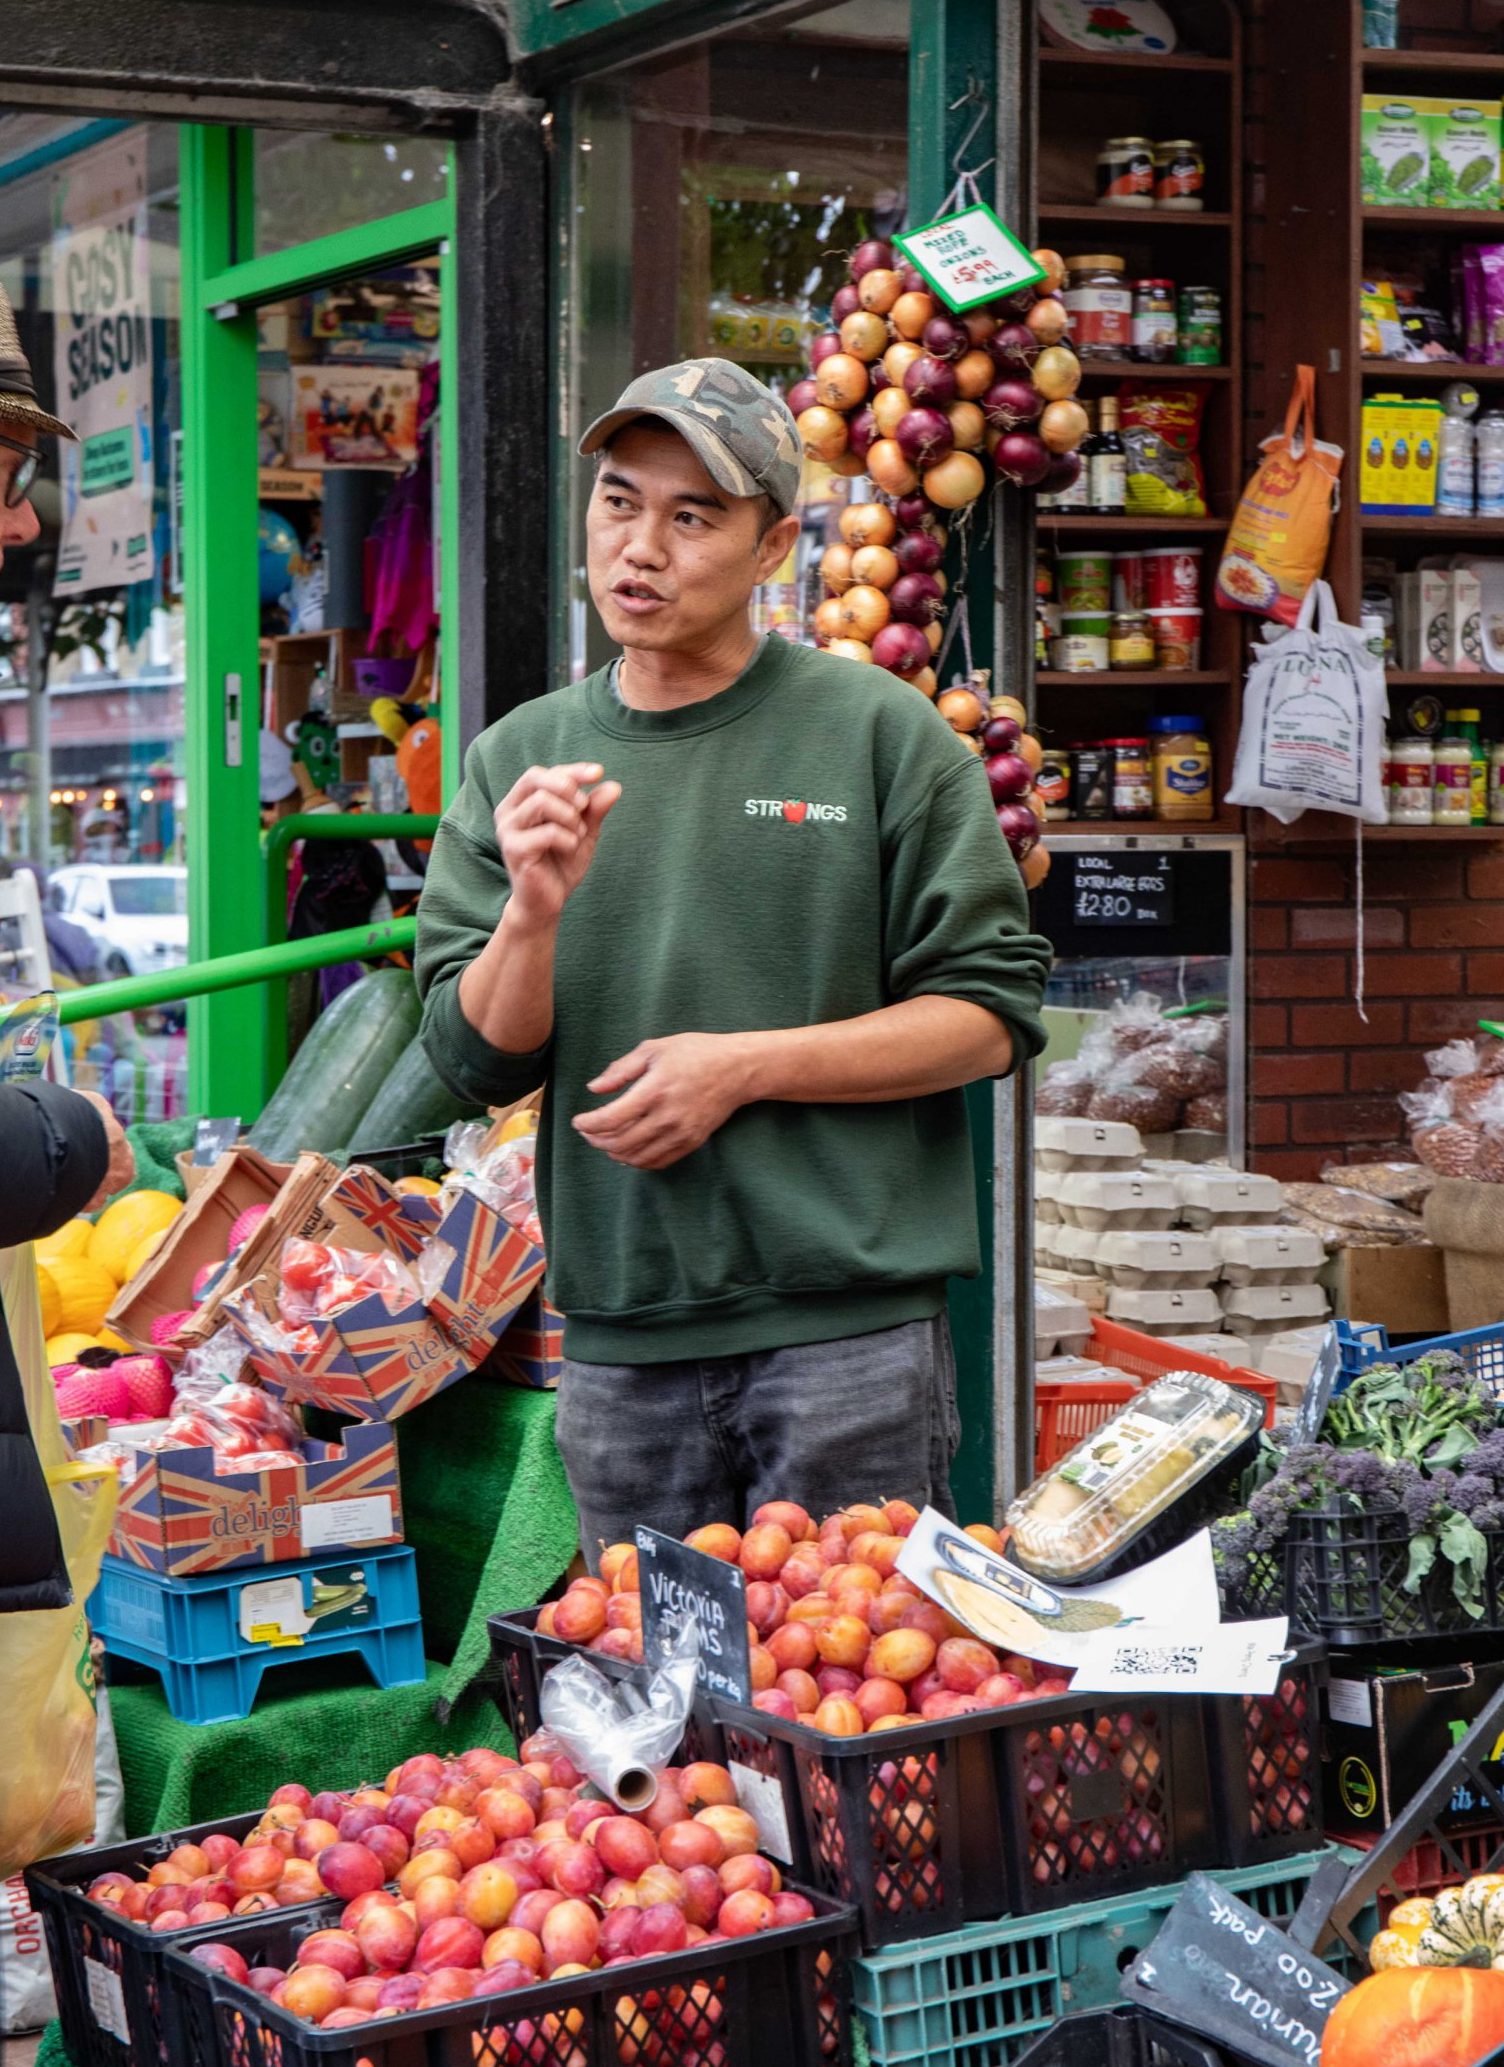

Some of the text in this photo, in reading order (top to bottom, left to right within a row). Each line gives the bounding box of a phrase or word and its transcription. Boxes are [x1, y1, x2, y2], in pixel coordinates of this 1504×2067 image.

[923, 229, 965, 248] MIXED
[939, 245, 987, 268] ONIONS
[67, 217, 135, 330] COSY
[982, 270, 1016, 285] EACH
[68, 307, 147, 401] SEASON
[1078, 857, 1114, 870] LOCAL
[211, 1496, 304, 1538] deligh
[1277, 1952, 1341, 2016] 2.00
